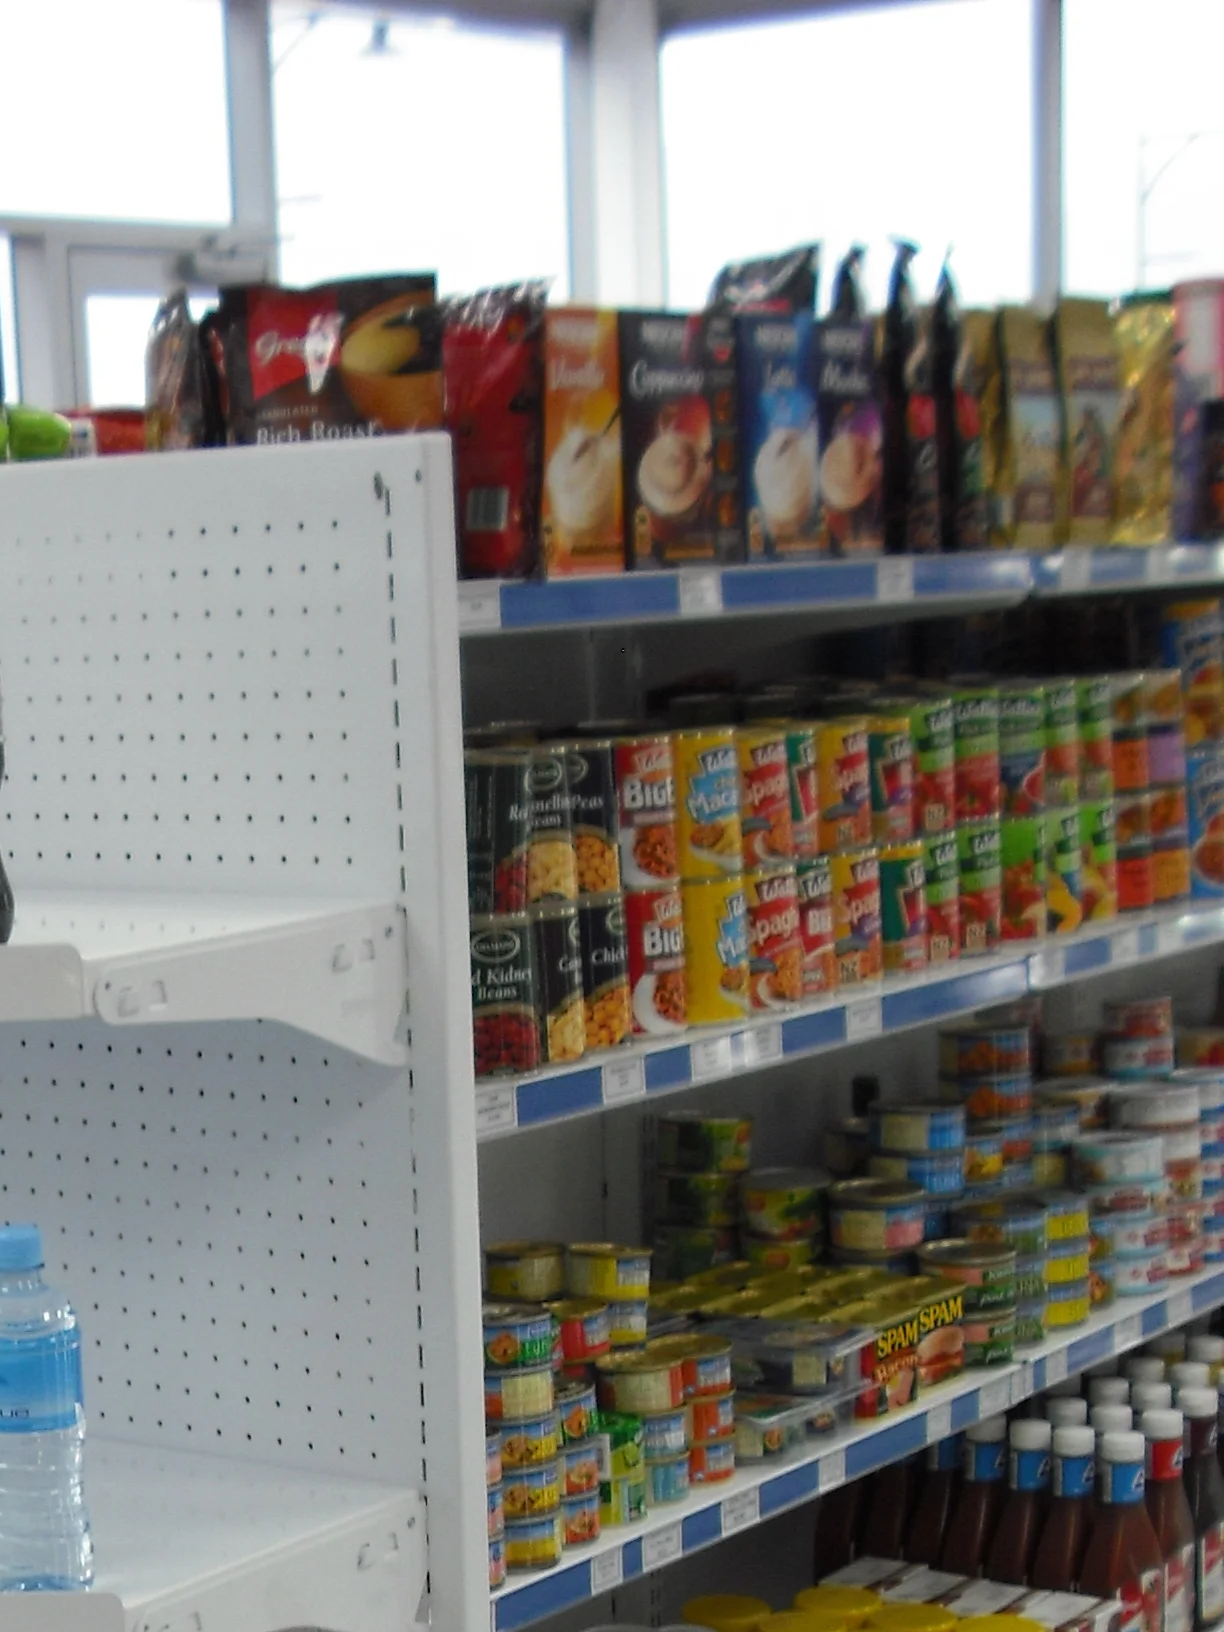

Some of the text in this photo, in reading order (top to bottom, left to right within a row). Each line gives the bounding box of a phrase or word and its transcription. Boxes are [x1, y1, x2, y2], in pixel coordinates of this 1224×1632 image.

[256, 423, 301, 445] Rich
[919, 1296, 964, 1333] SPAM
[877, 1319, 920, 1360] SPAM
